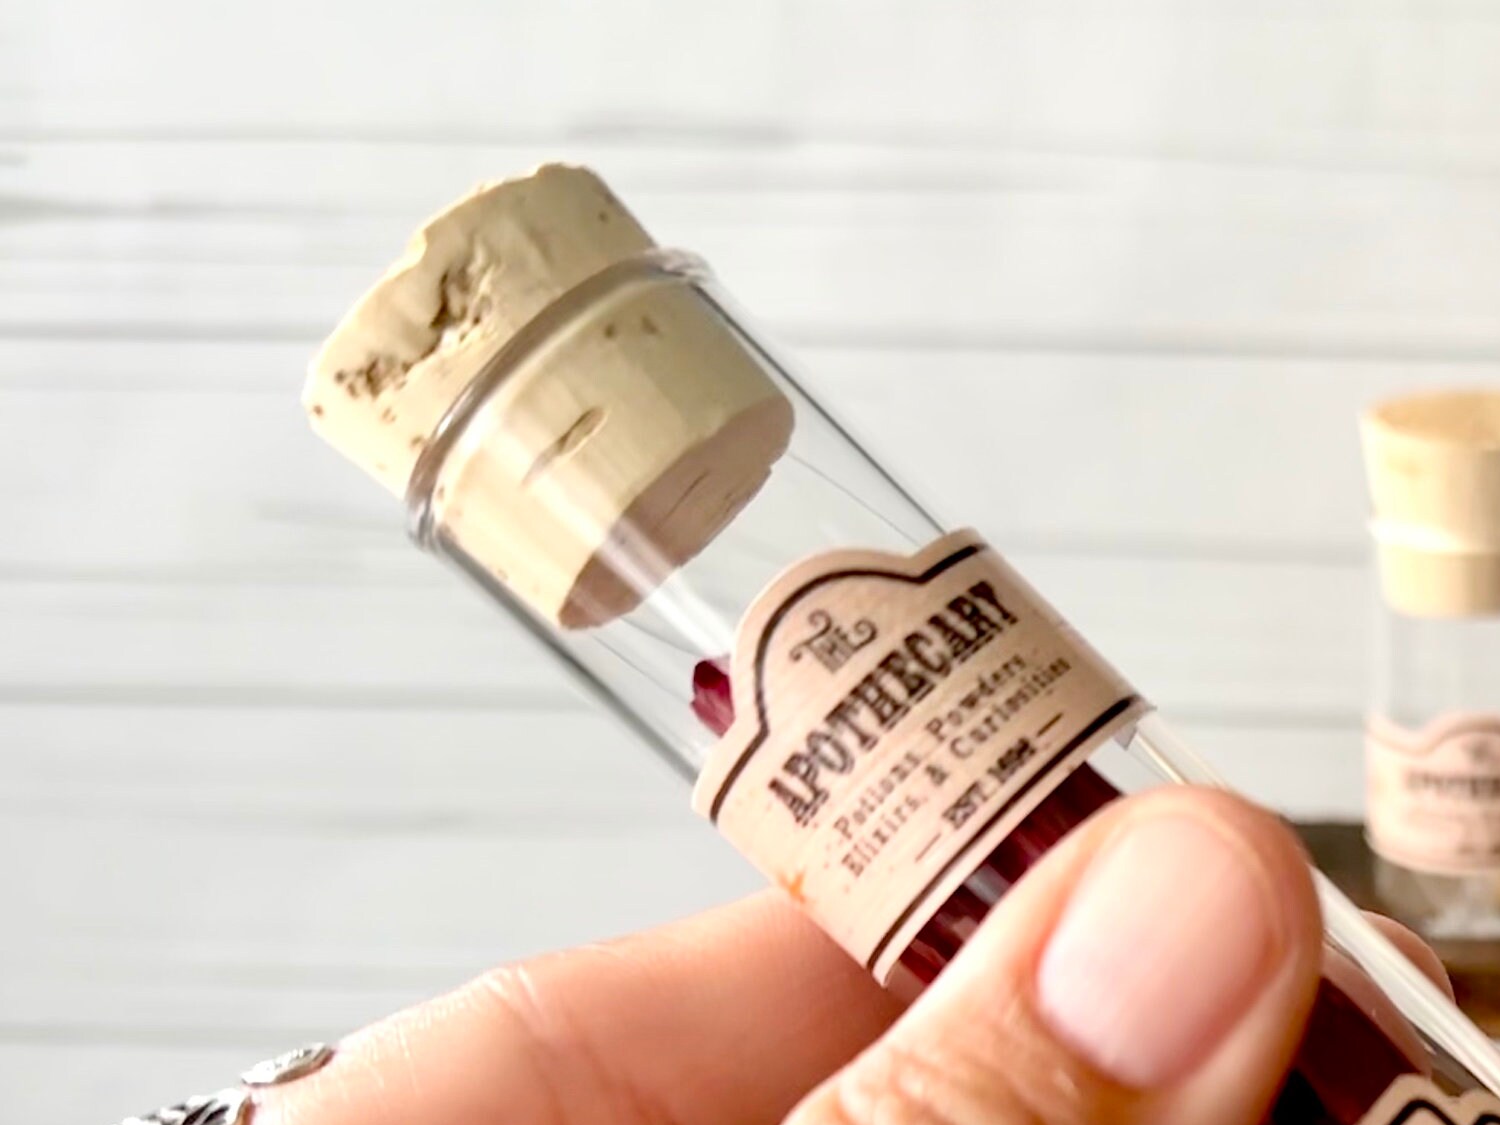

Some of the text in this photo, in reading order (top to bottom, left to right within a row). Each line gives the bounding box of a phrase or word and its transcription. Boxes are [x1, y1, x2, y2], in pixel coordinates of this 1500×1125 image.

[768, 580, 1019, 828] APOTHECARY
[925, 765, 947, 786] &
[951, 658, 1071, 759] Curiosities
